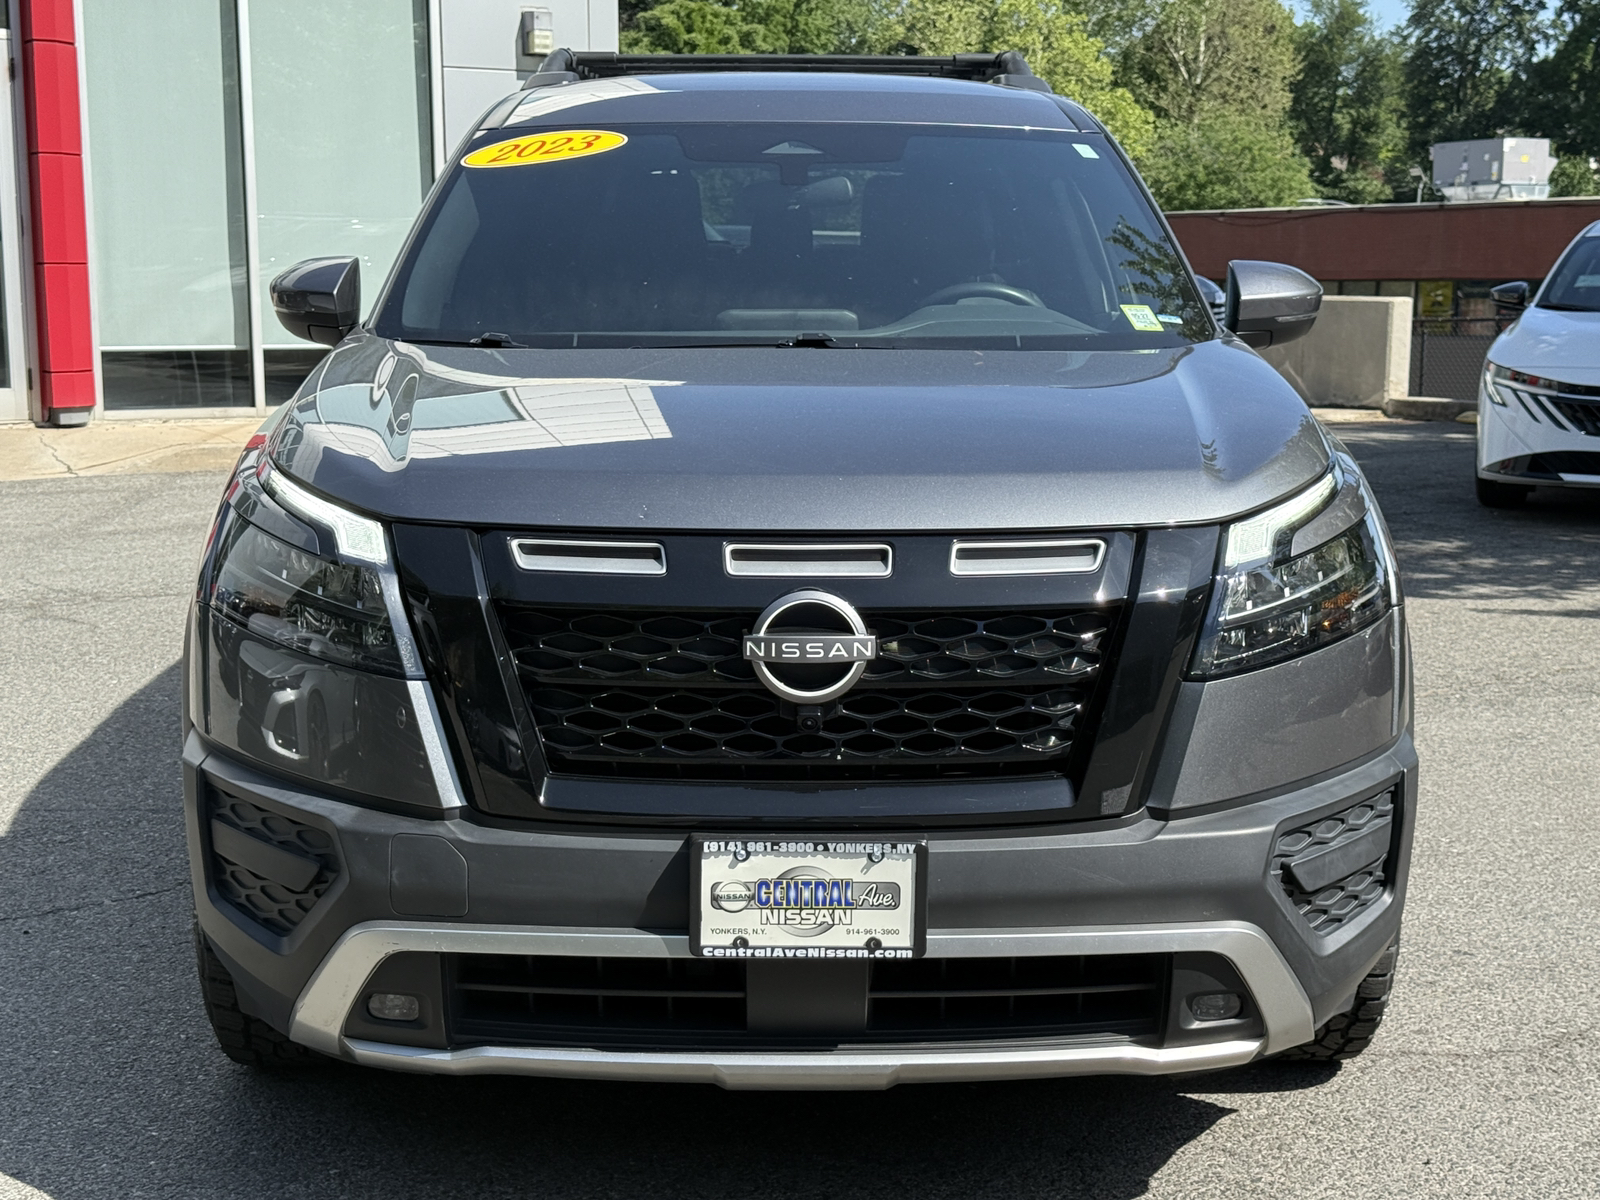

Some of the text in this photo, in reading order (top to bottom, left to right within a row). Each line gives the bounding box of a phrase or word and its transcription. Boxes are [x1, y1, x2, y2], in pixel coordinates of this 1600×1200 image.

[486, 134, 602, 163] 2023
[746, 641, 872, 657] NISSAN
[747, 841, 814, 852] 961-3900
[755, 879, 896, 908] CENTRAL Ave.
[760, 908, 853, 925] NISSAN
[710, 928, 750, 937] YONKERS,
[846, 928, 900, 936] 914-961-3900
[703, 947, 912, 958] CentralAveNissan.com
